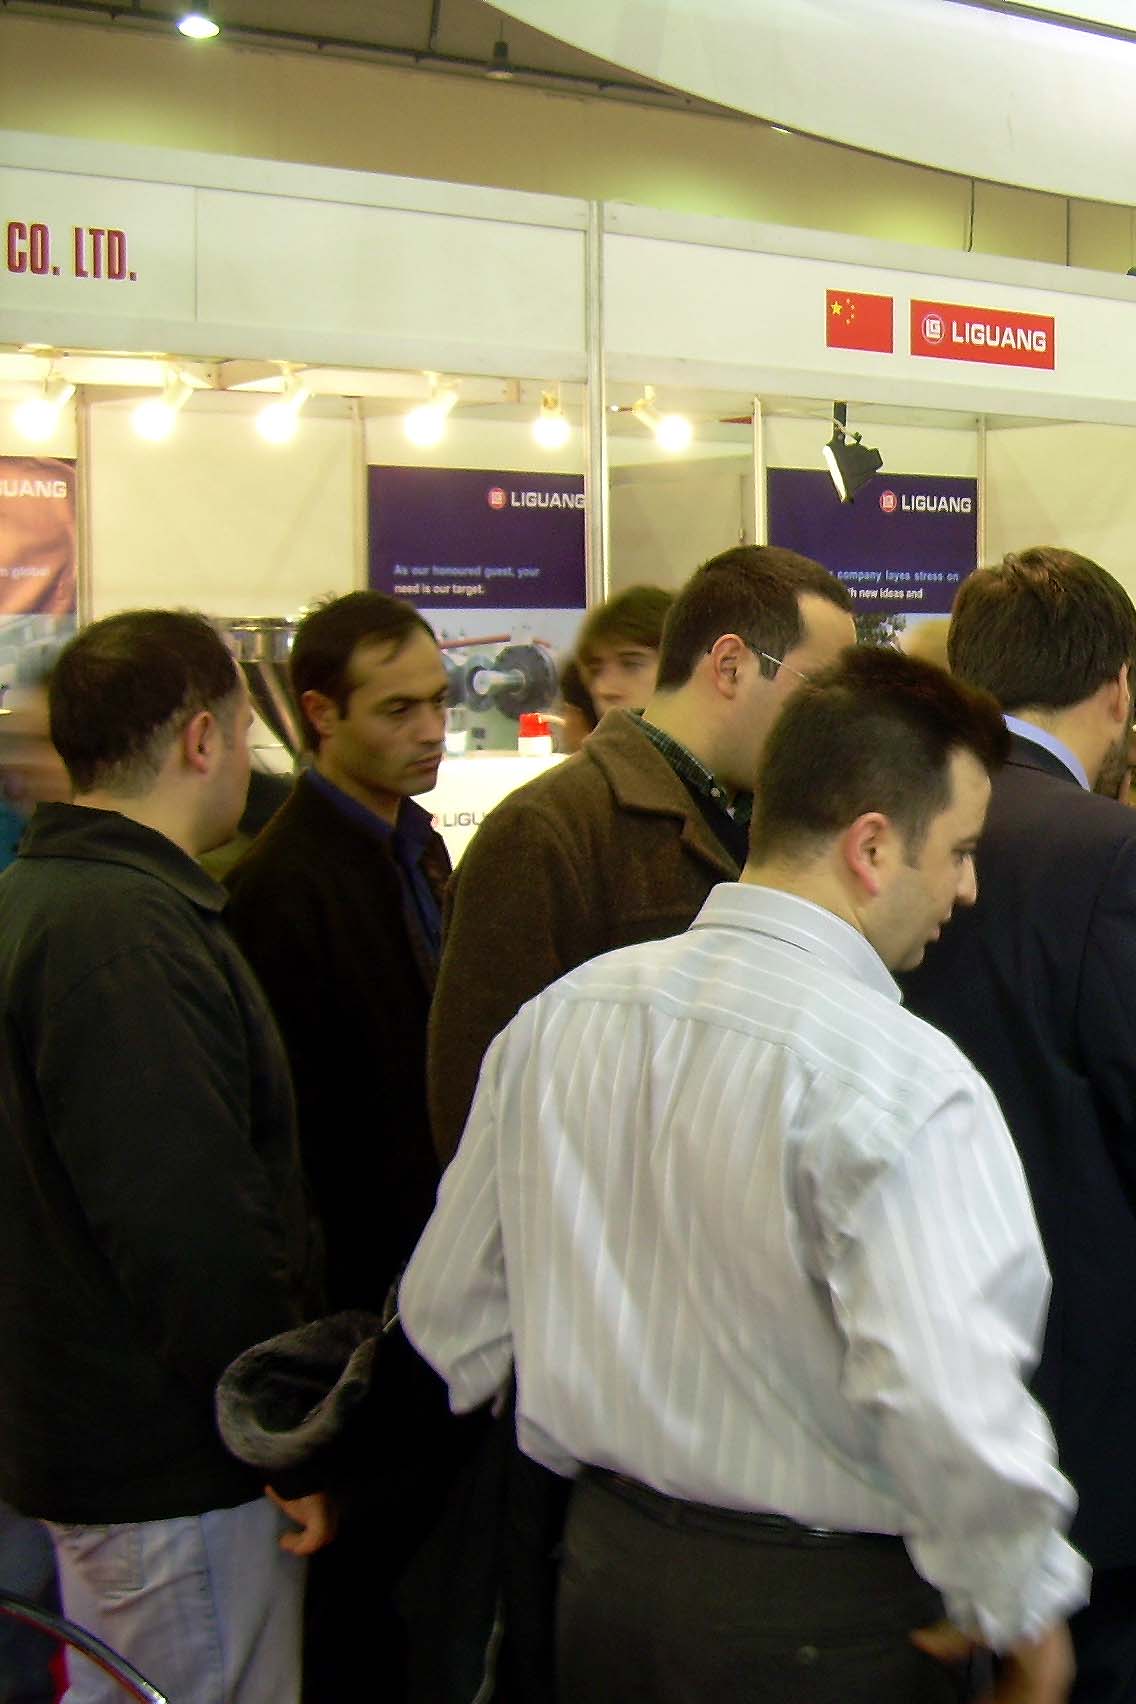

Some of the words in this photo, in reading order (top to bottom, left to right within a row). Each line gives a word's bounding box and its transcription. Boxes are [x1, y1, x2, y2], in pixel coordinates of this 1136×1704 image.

[7, 222, 60, 275] CO.
[74, 227, 137, 281] LTD.
[952, 320, 1047, 352] LIGUANG
[511, 491, 584, 509] LIGUANG
[902, 495, 972, 512] LIGUANG
[394, 564, 409, 576] As
[411, 566, 430, 576] our
[432, 565, 481, 577] honoured
[518, 567, 540, 579] your
[837, 570, 881, 582] company
[914, 571, 943, 581] stress
[947, 573, 959, 581] on
[394, 584, 419, 595] need
[422, 584, 430, 594] is
[433, 585, 451, 595] our
[859, 589, 878, 599] new
[880, 588, 905, 599] ideas
[906, 588, 923, 599] and
